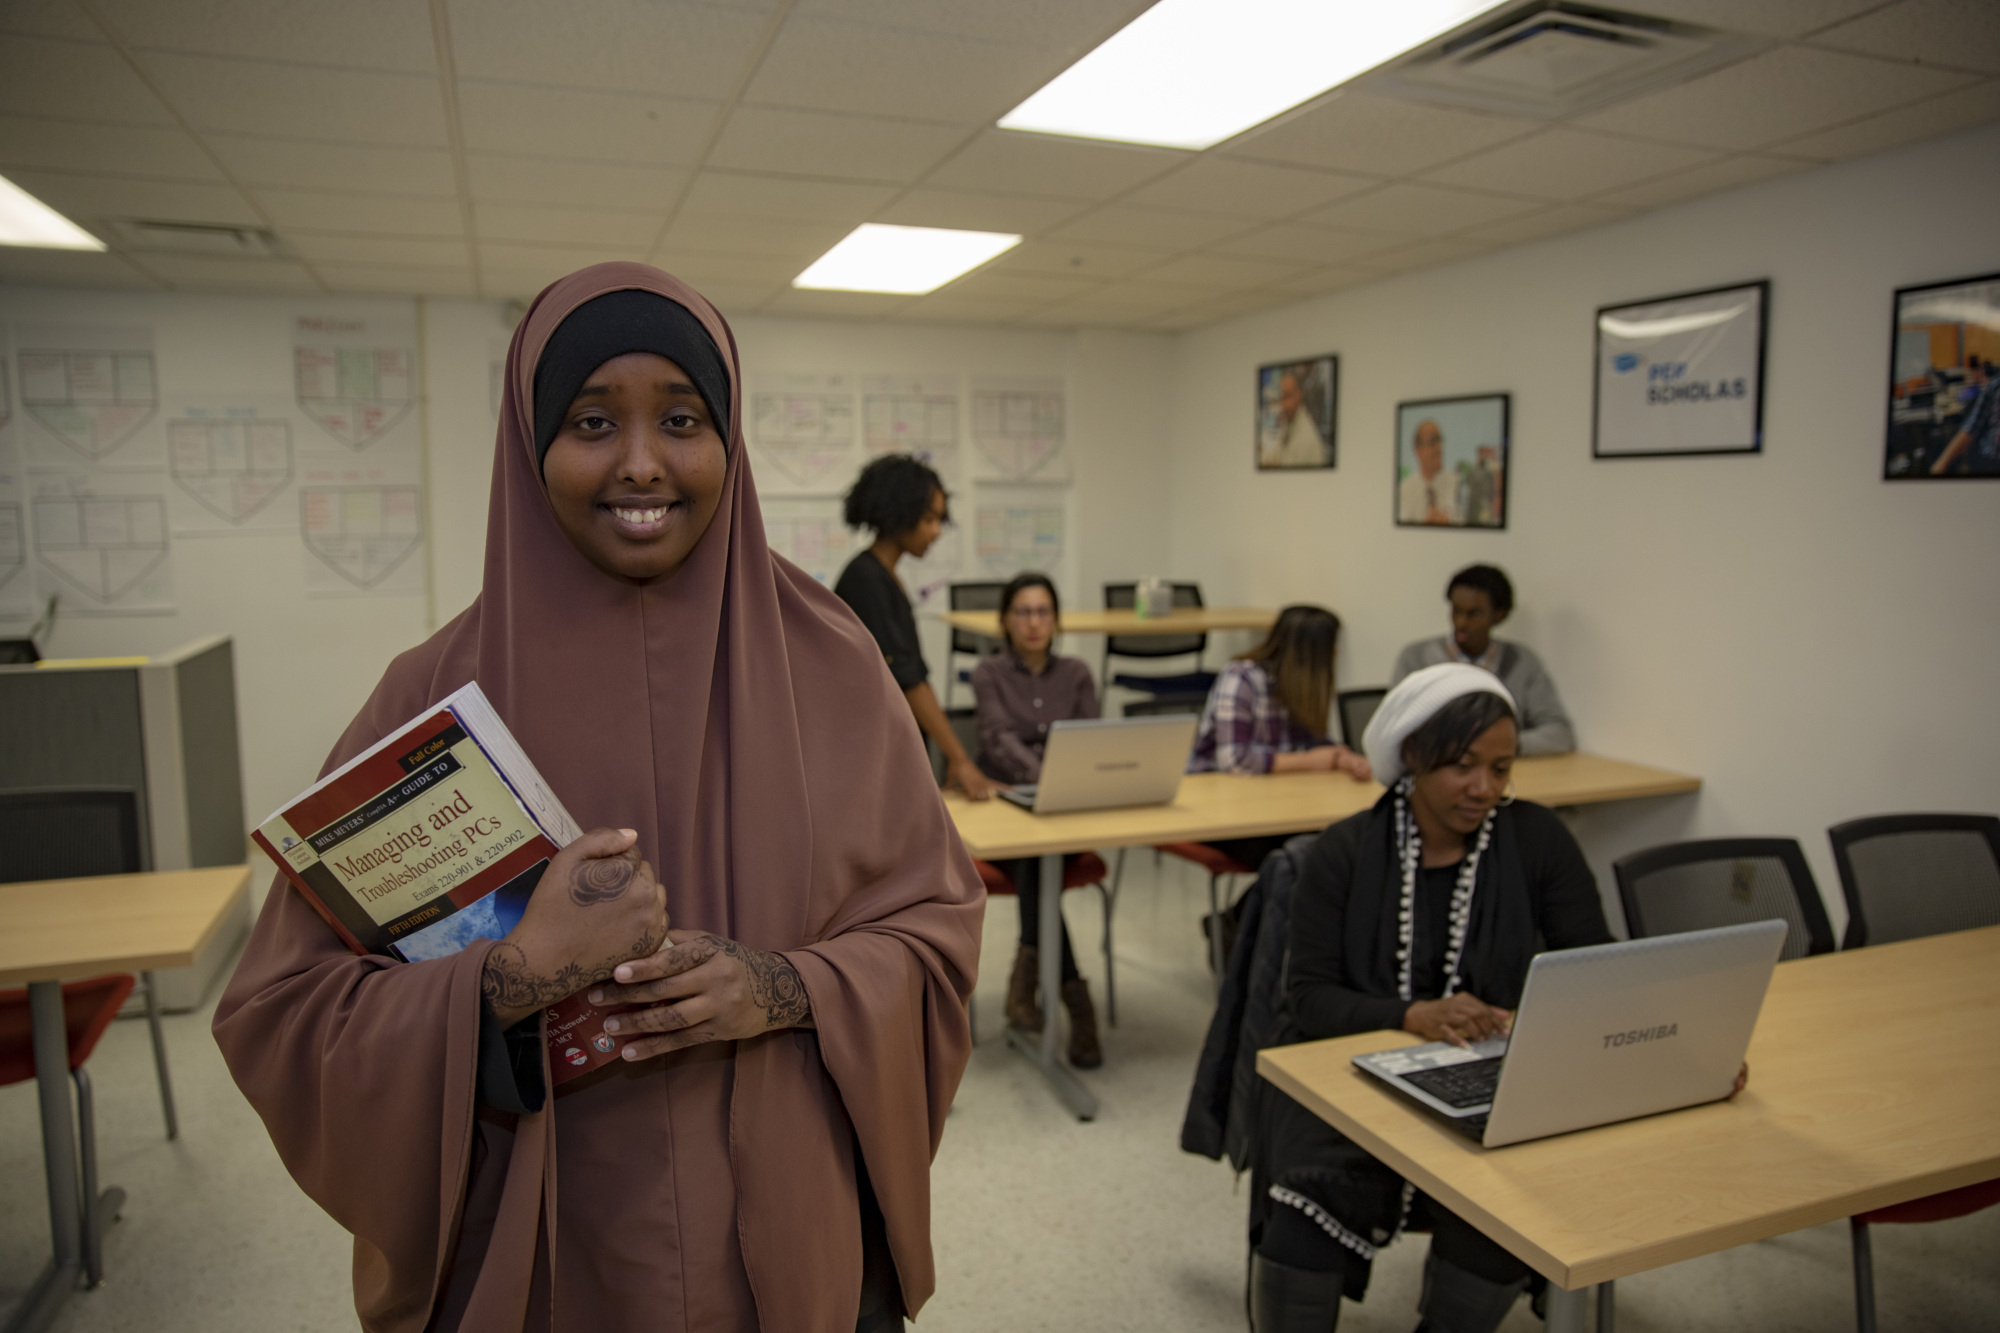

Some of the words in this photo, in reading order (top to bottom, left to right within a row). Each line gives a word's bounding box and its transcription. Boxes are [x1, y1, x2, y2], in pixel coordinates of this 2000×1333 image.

[1649, 378, 1746, 405] SCHOLAS
[408, 750, 426, 766] Full
[423, 738, 446, 756] Color
[314, 832, 336, 848] MIKE
[401, 771, 434, 796] GUIDE
[432, 762, 449, 776] TO
[333, 823, 432, 882] Managing
[428, 789, 474, 831] and
[356, 839, 469, 903] Troubleshooting
[462, 815, 502, 845] PCs
[412, 883, 440, 902] Exams
[438, 861, 474, 888] 220-901
[474, 855, 486, 867] &
[484, 829, 525, 860] 220-902
[388, 921, 412, 936] FIFTH
[410, 905, 441, 927] EDITION
[1603, 1023, 1678, 1049] TOSHIBA
